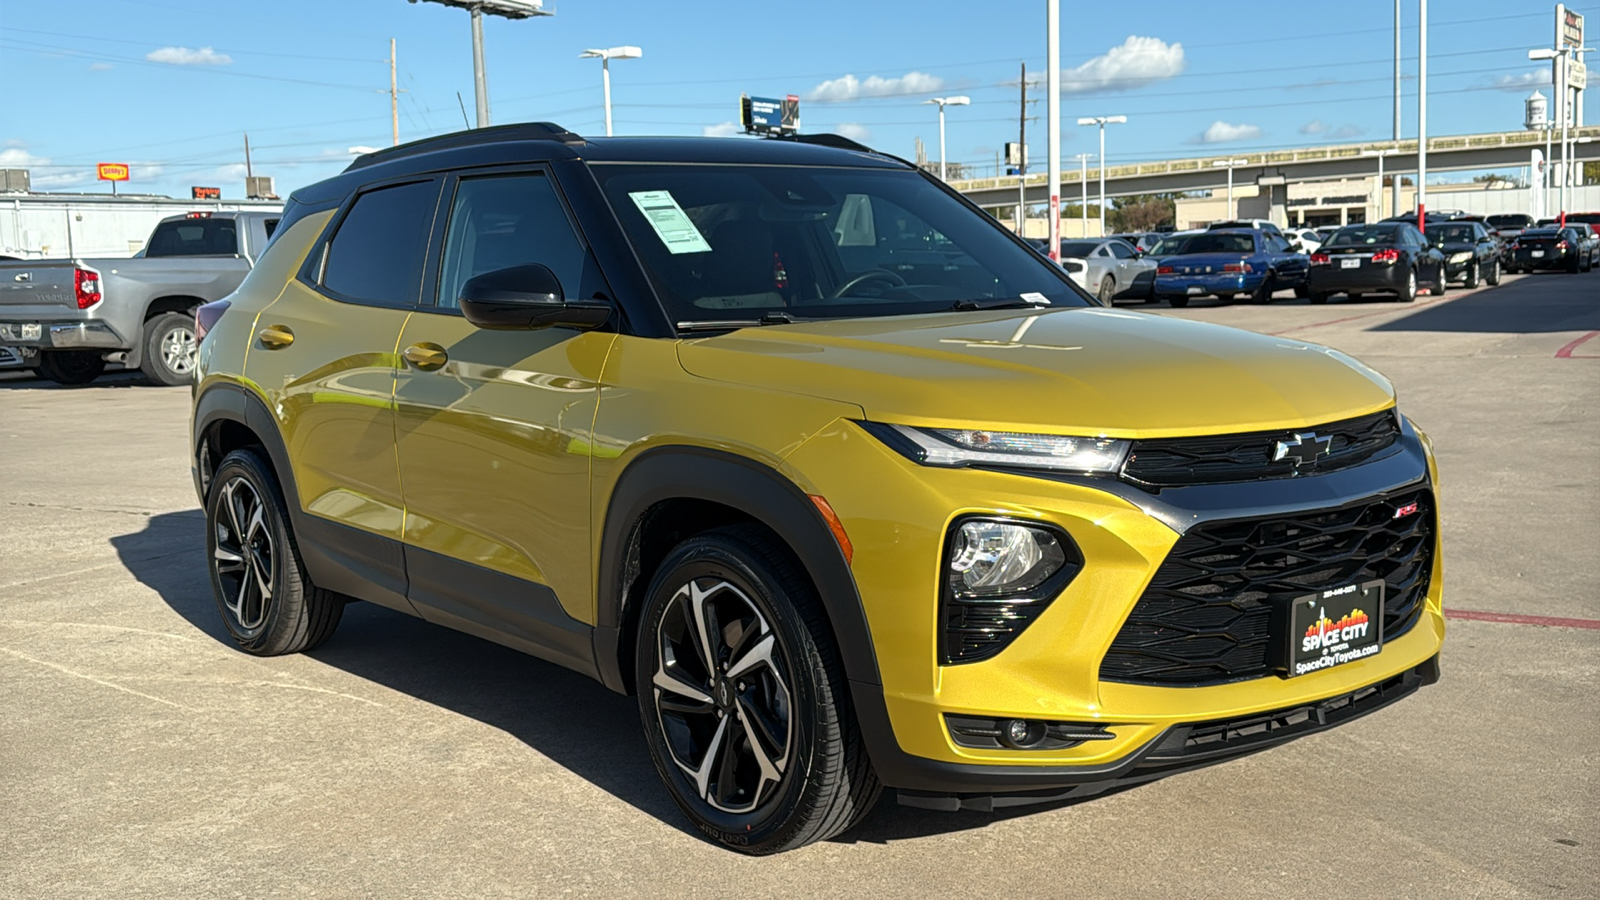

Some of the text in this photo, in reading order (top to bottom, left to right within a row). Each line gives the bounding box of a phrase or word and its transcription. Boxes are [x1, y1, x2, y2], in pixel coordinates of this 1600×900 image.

[103, 167, 125, 176] Denny's
[1396, 501, 1418, 517] RS
[1302, 621, 1369, 652] SPACE CITY
[1330, 643, 1349, 653] TOYOTA
[1296, 644, 1379, 674] SpaceCityToyota.com
